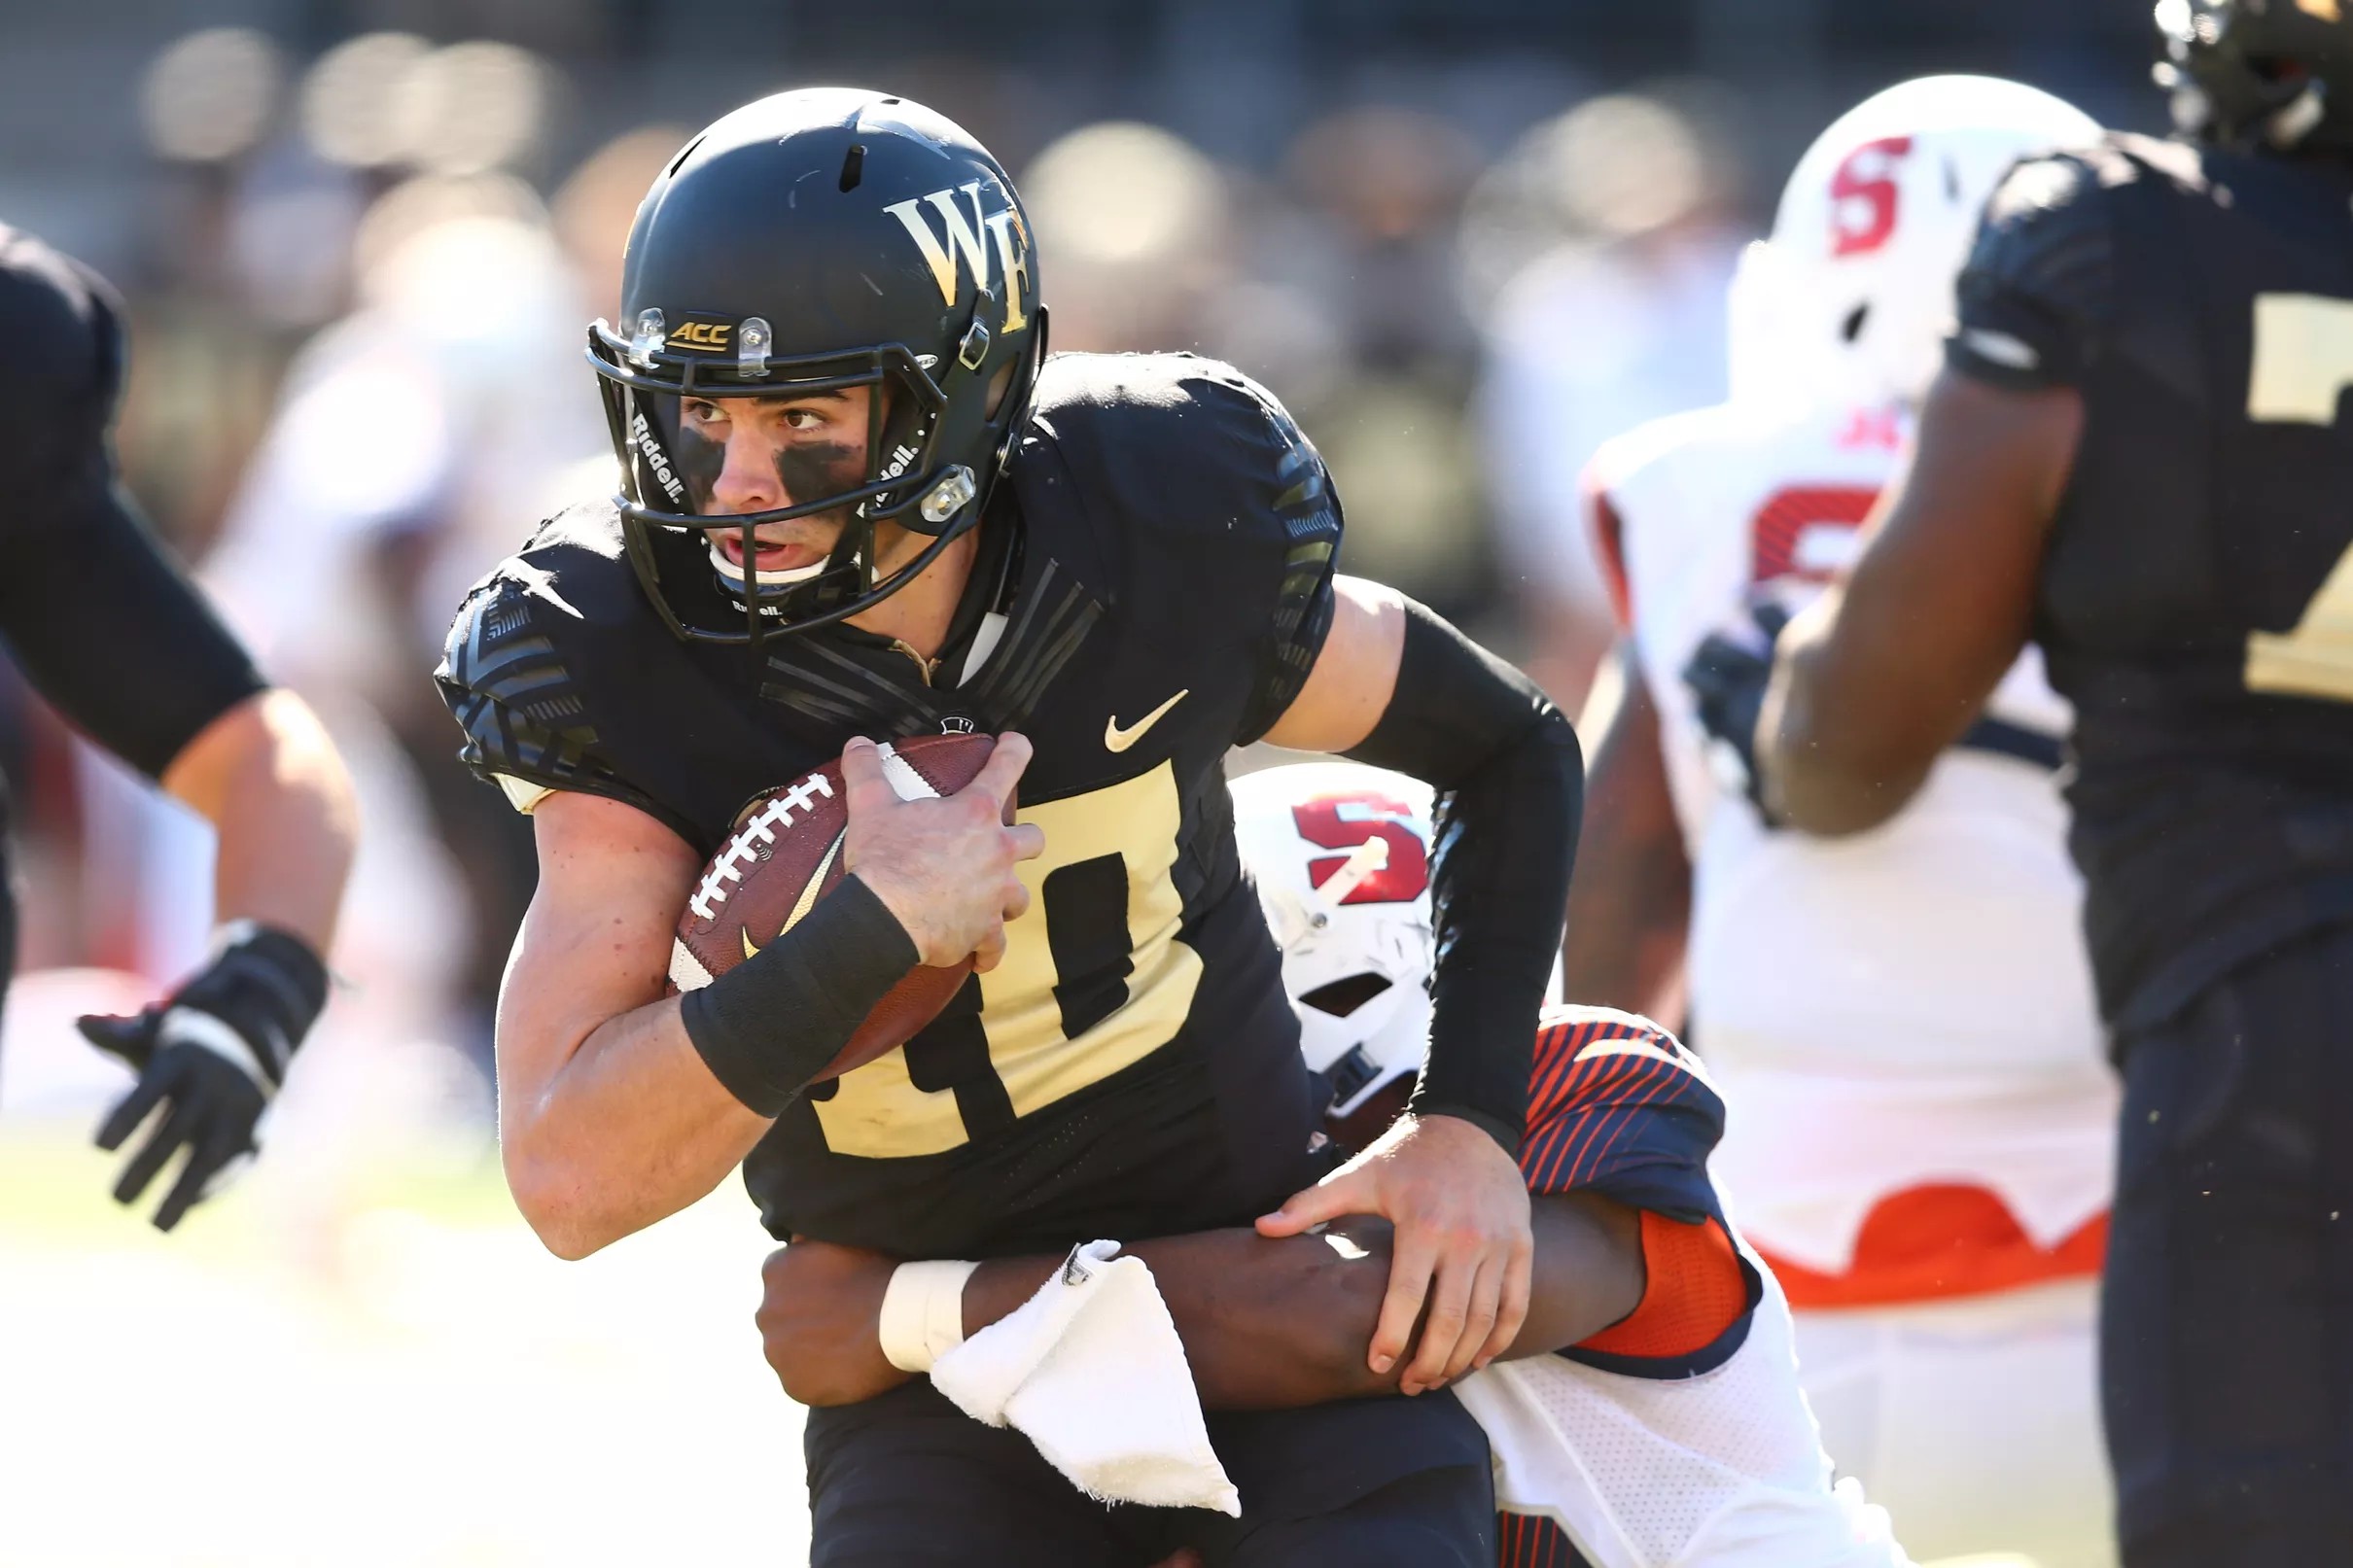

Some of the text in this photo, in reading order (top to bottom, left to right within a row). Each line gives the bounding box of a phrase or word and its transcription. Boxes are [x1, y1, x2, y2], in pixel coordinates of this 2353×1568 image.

[882, 181, 1030, 334] WF
[1831, 136, 1912, 258] S
[670, 322, 732, 344] ACC
